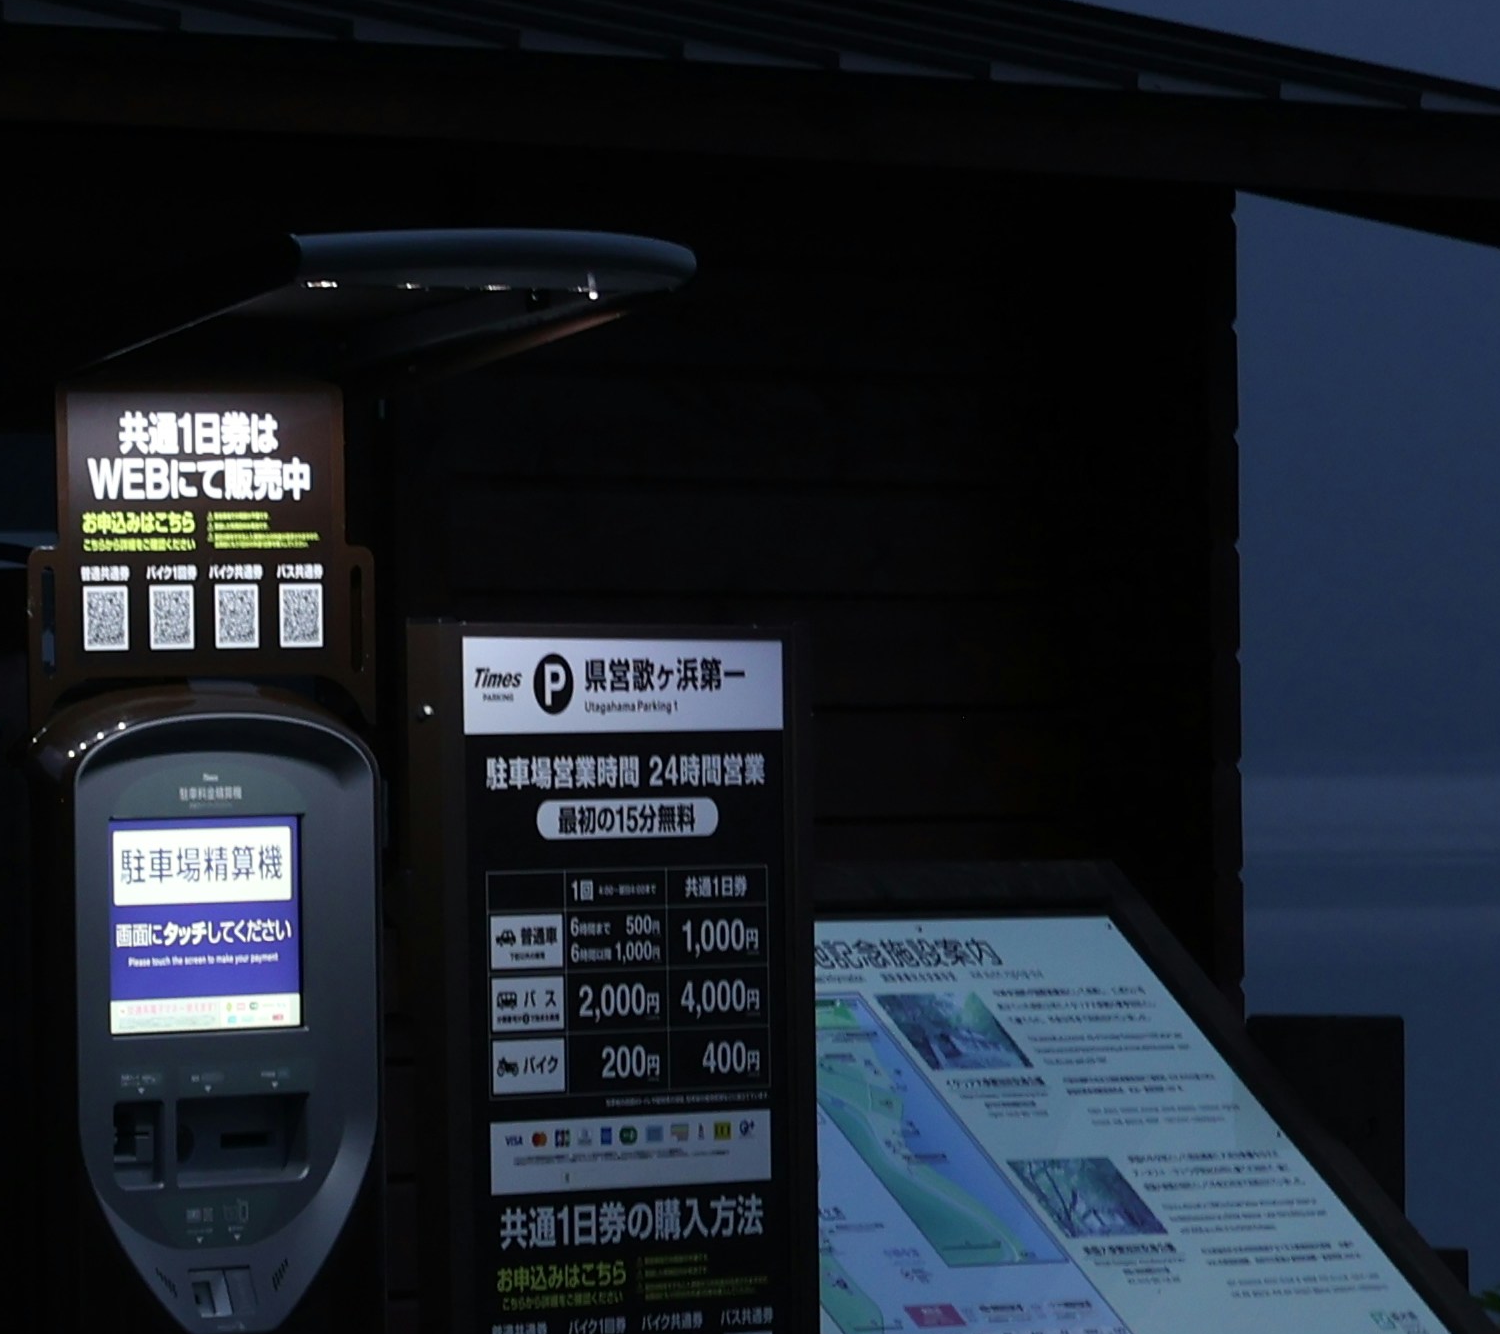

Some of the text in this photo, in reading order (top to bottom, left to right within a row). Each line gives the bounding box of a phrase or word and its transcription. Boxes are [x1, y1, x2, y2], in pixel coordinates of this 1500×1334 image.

[119, 411, 278, 455] 共通1日券は
[87, 458, 310, 500] WEBにて販売中
[82, 511, 195, 534] お申込みはこちら
[475, 668, 522, 688] Times
[585, 701, 635, 715] Utagahama
[638, 701, 672, 715] Parking
[485, 752, 766, 791] 駐車場営業時間 24時間営業
[558, 804, 695, 834] 最初の15分無料
[121, 845, 282, 885] 駐車場精算機
[685, 874, 749, 898] 共通1日券
[116, 919, 291, 947] 画面にタッチしてください
[625, 914, 662, 936] 500円
[682, 918, 760, 956] 1,000円
[128, 952, 279, 967] Please touch the screen to make your payment
[524, 989, 556, 1007] バス
[578, 983, 660, 1023] 2,000円
[680, 978, 760, 1019] 4,000円
[523, 1053, 558, 1074] バイク
[601, 1044, 660, 1079] 200円
[702, 1039, 761, 1075] 400円
[505, 1135, 523, 1146] VISA
[499, 1192, 765, 1251] 共通1日券の購入方法
[496, 1259, 626, 1293] お申込みはこちら
